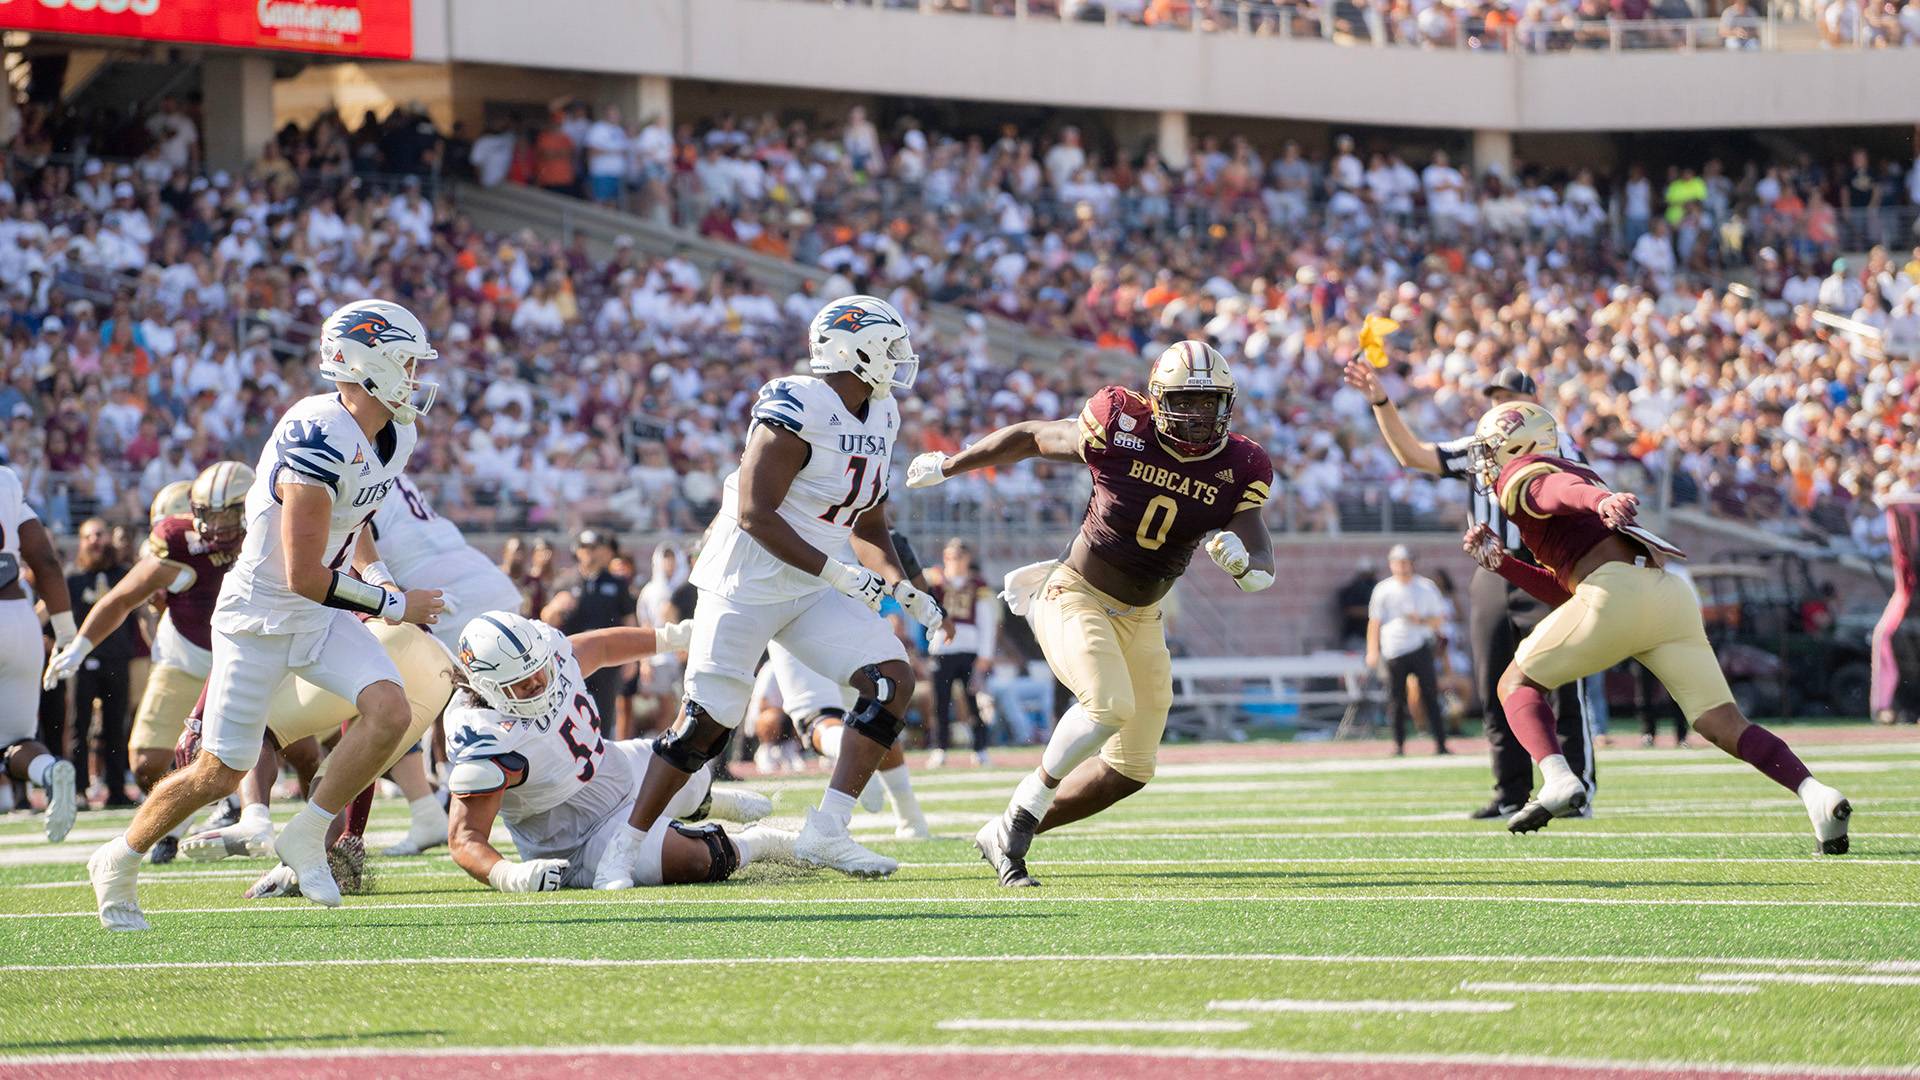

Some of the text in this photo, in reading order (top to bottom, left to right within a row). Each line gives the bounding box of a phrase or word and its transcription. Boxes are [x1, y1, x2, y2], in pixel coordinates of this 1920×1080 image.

[838, 434, 887, 456] UTSA
[352, 478, 395, 508] UTS
[1128, 459, 1219, 506] BOBCATS
[1135, 494, 1179, 551] 0
[523, 658, 538, 671] UTSA
